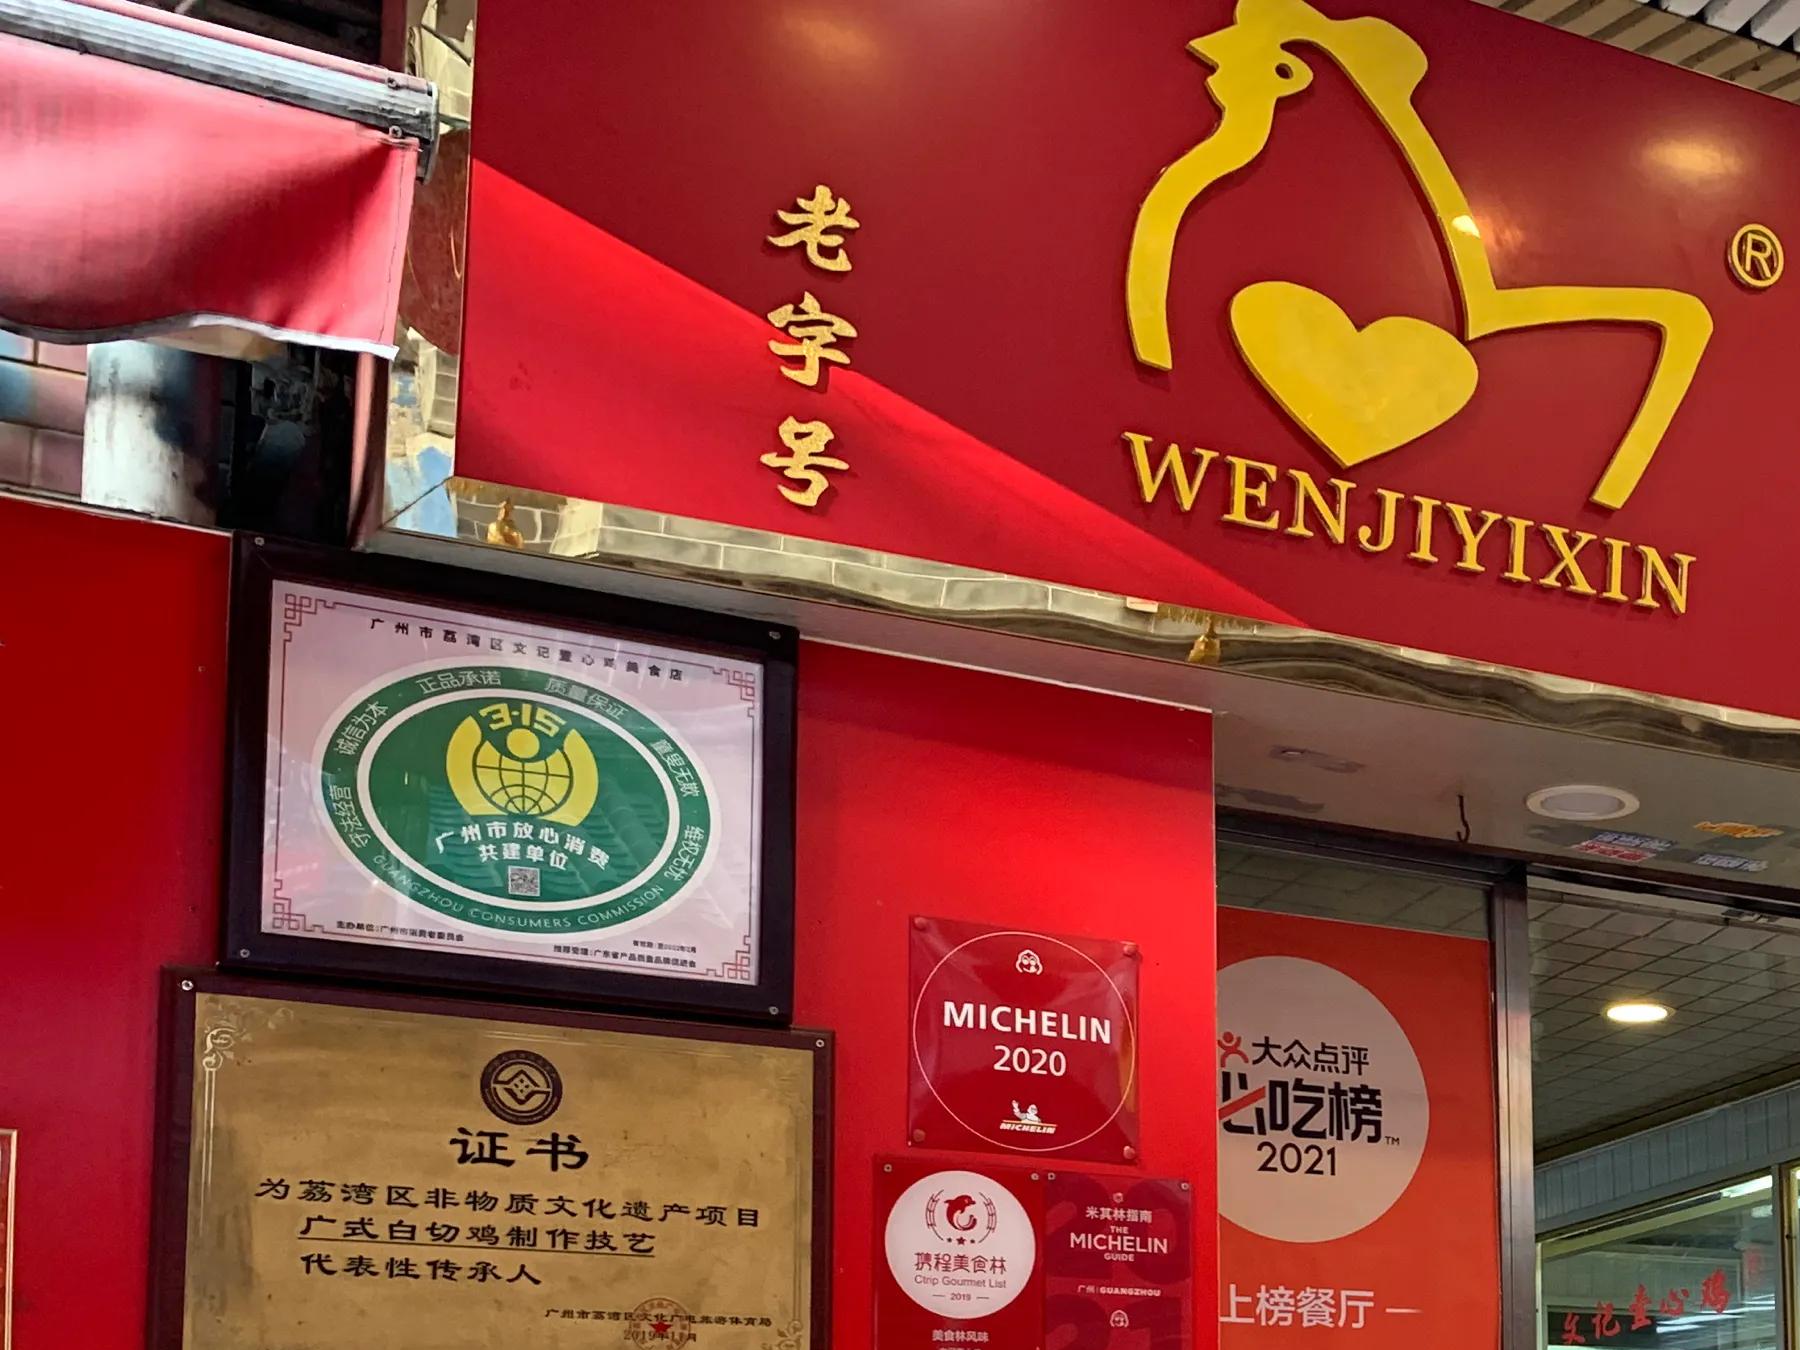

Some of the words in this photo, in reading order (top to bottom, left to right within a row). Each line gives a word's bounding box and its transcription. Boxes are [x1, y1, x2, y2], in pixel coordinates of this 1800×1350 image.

[766, 184, 860, 508] 老字号
[1121, 431, 1696, 615] WENJIYIXIN
[415, 670, 501, 695] 正品承诺
[333, 700, 389, 756] 诚信为本
[328, 784, 372, 849] 守法经营
[435, 820, 611, 872] 广州市放心消费
[477, 843, 569, 872] 共建单位
[372, 853, 465, 914] GUANGZHOU
[468, 907, 572, 929] CONSUMERS
[576, 883, 665, 926] COMMISSION
[943, 1000, 1112, 1045] MICHELIN
[993, 1045, 1067, 1078] 2020
[1251, 1035, 1370, 1077] 大众点评
[449, 1126, 591, 1172] 证书
[1256, 1141, 1338, 1177] 2021
[255, 1177, 761, 1230] 为荔湾区非物质文化遗产项目
[1085, 1206, 1153, 1224] 米其林指南
[299, 1214, 655, 1255] 广式白切鸡制作技艺
[1069, 1231, 1169, 1255] MICHELIN
[1109, 1225, 1130, 1235] THE
[299, 1252, 543, 1287] 代表性传承人
[914, 1251, 1007, 1275] 携程美食林
[1103, 1252, 1135, 1262] GUIDE
[914, 1273, 939, 1286] Ctrip
[941, 1275, 986, 1288] Gourmet
[988, 1278, 1007, 1289] List
[949, 1292, 972, 1301] 2019
[1099, 1286, 1161, 1298] GUANGZHOU
[1560, 1268, 1734, 1346] 文记壹心鸡
